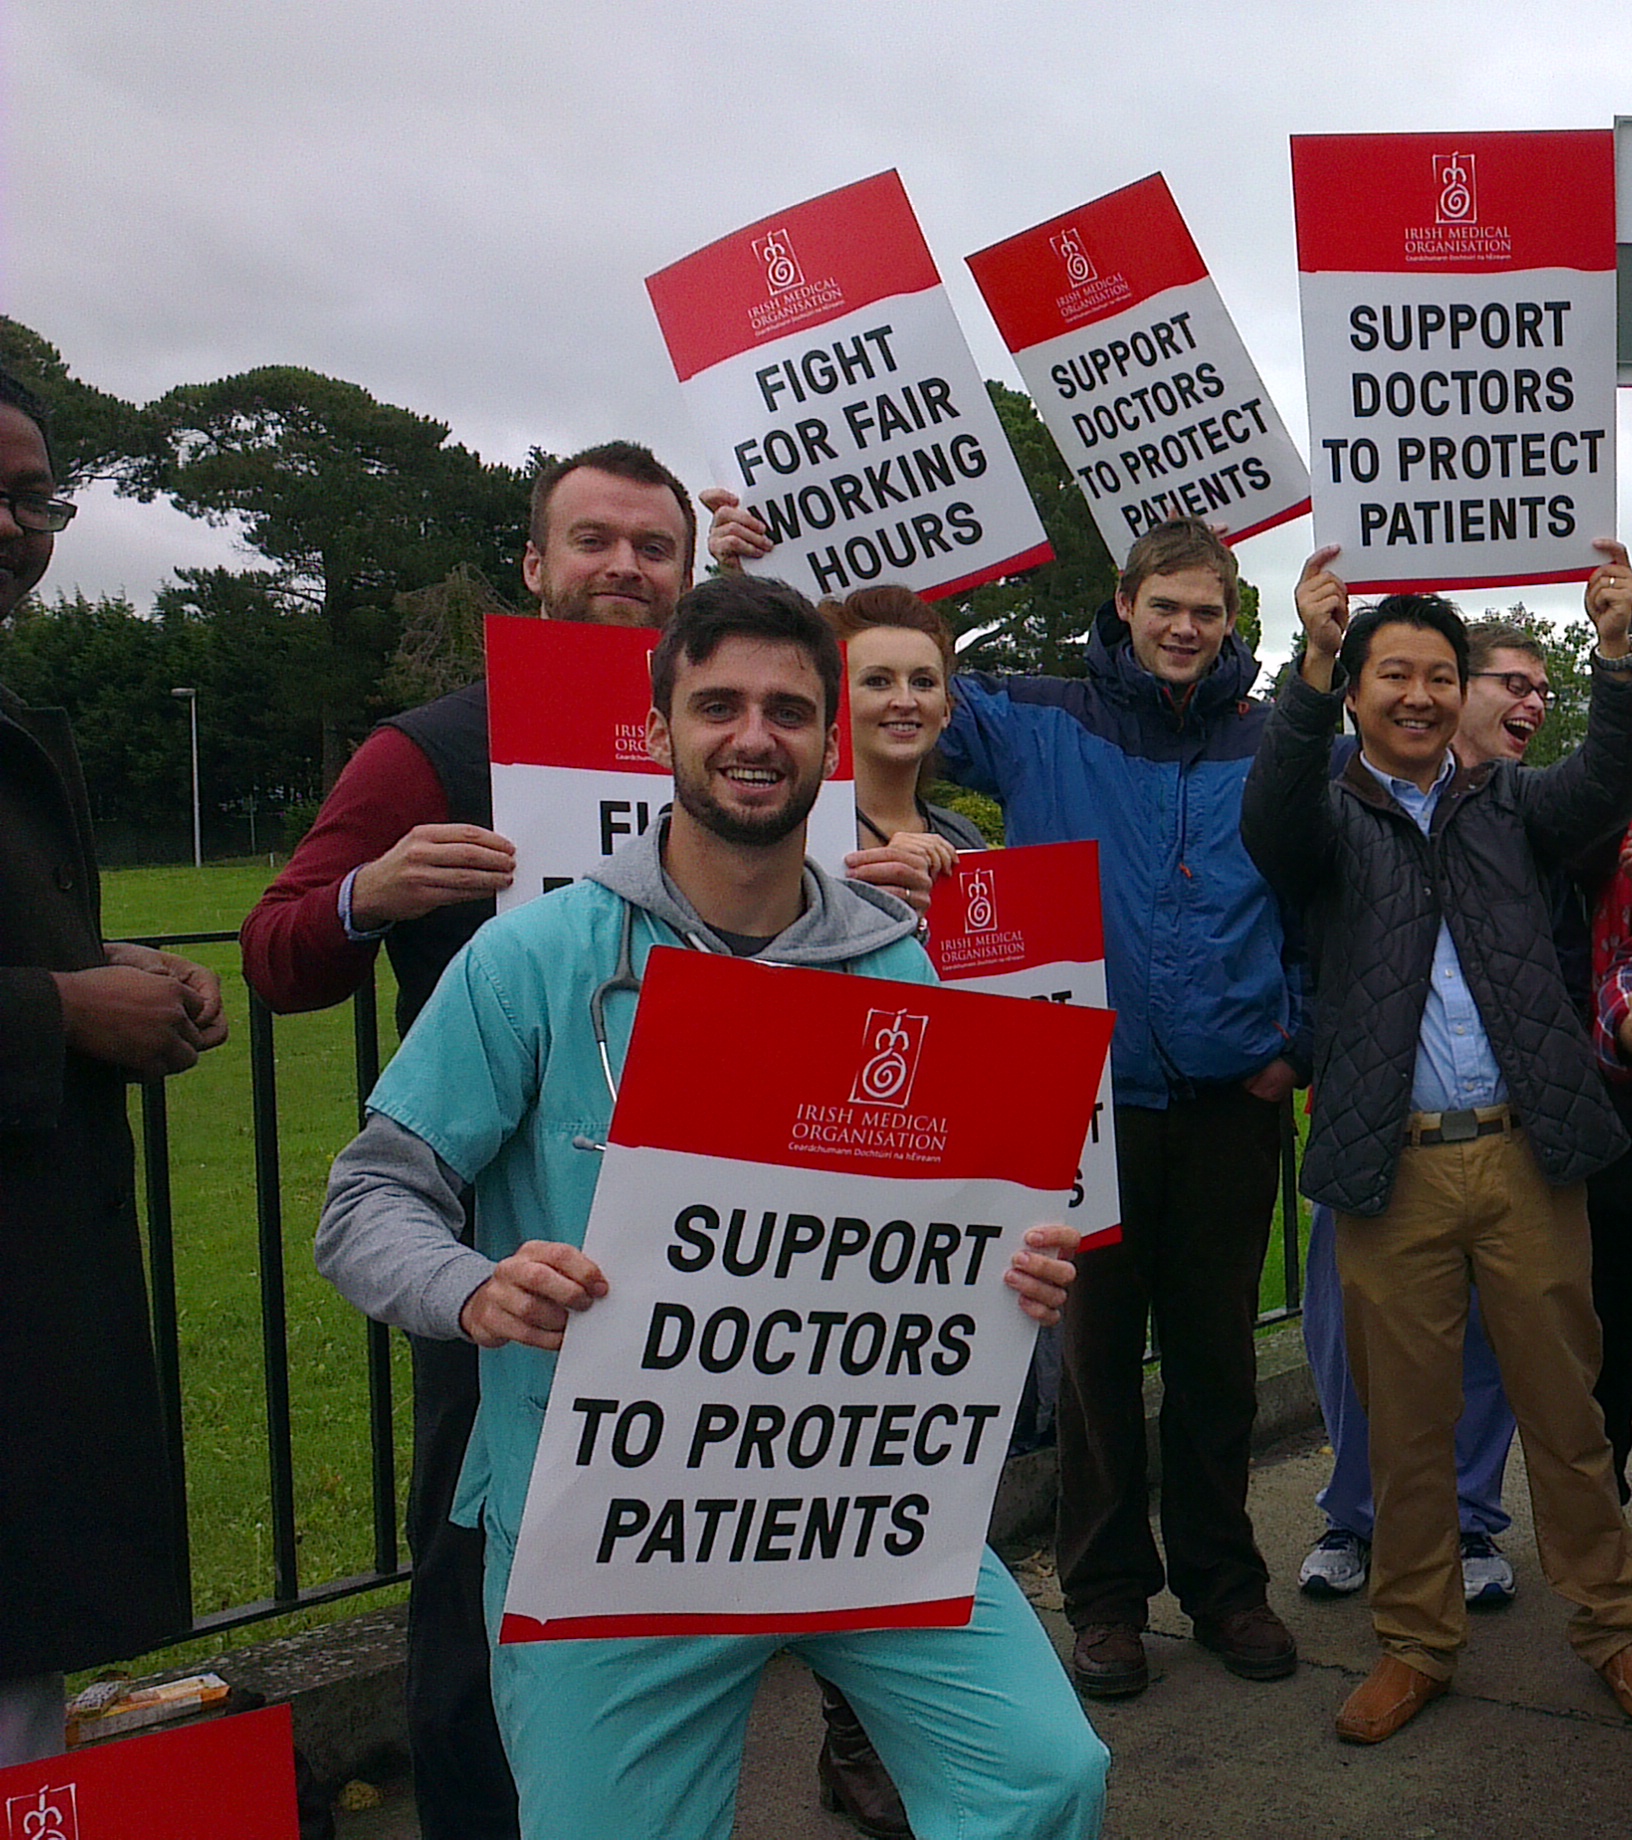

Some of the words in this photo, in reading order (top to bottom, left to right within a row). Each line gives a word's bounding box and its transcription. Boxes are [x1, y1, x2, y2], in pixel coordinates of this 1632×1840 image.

[1404, 239, 1512, 254] ORGANISATION
[1405, 227, 1443, 240] IRISH
[1448, 226, 1512, 240] MEDICAL
[747, 297, 780, 319] IRISH
[783, 276, 839, 305] MEDICAL
[751, 287, 843, 330] ORGANISATION
[1056, 289, 1081, 308] IRISH
[1082, 271, 1124, 296] MEDICAL
[1060, 281, 1130, 318] ORGANISATION
[1349, 301, 1571, 351] SUPPORT
[755, 325, 897, 413] FIGHT
[1051, 311, 1197, 399] SUPPORT
[1071, 362, 1225, 448] DOCTORS
[1352, 367, 1574, 418] DOCTORS
[734, 418, 839, 487] FOR
[842, 377, 961, 450] FAIR
[1077, 460, 1121, 500] TO
[1120, 397, 1268, 486] PROTECT
[1322, 437, 1380, 483] TO
[1397, 429, 1605, 482] PROTECT
[747, 434, 988, 546] WORKING
[1121, 456, 1271, 538] PATIENTS
[1360, 494, 1576, 547] PATIENTS
[806, 501, 983, 594] HOURS
[614, 723, 645, 738] IRIS
[940, 937, 972, 952] IRISH
[975, 930, 1024, 946] MEDICAL
[941, 942, 1025, 963] ORGANISATION
[791, 1122, 947, 1152] ORGANISATION
[796, 1103, 854, 1125] IRISH
[861, 1111, 949, 1134] MEDICAL
[667, 1204, 1003, 1285] SUPPORT
[641, 1301, 976, 1376] DOCTORS
[572, 1397, 665, 1469] TO
[686, 1403, 1001, 1470] PROTECT
[595, 1493, 930, 1564] PATIENTS
